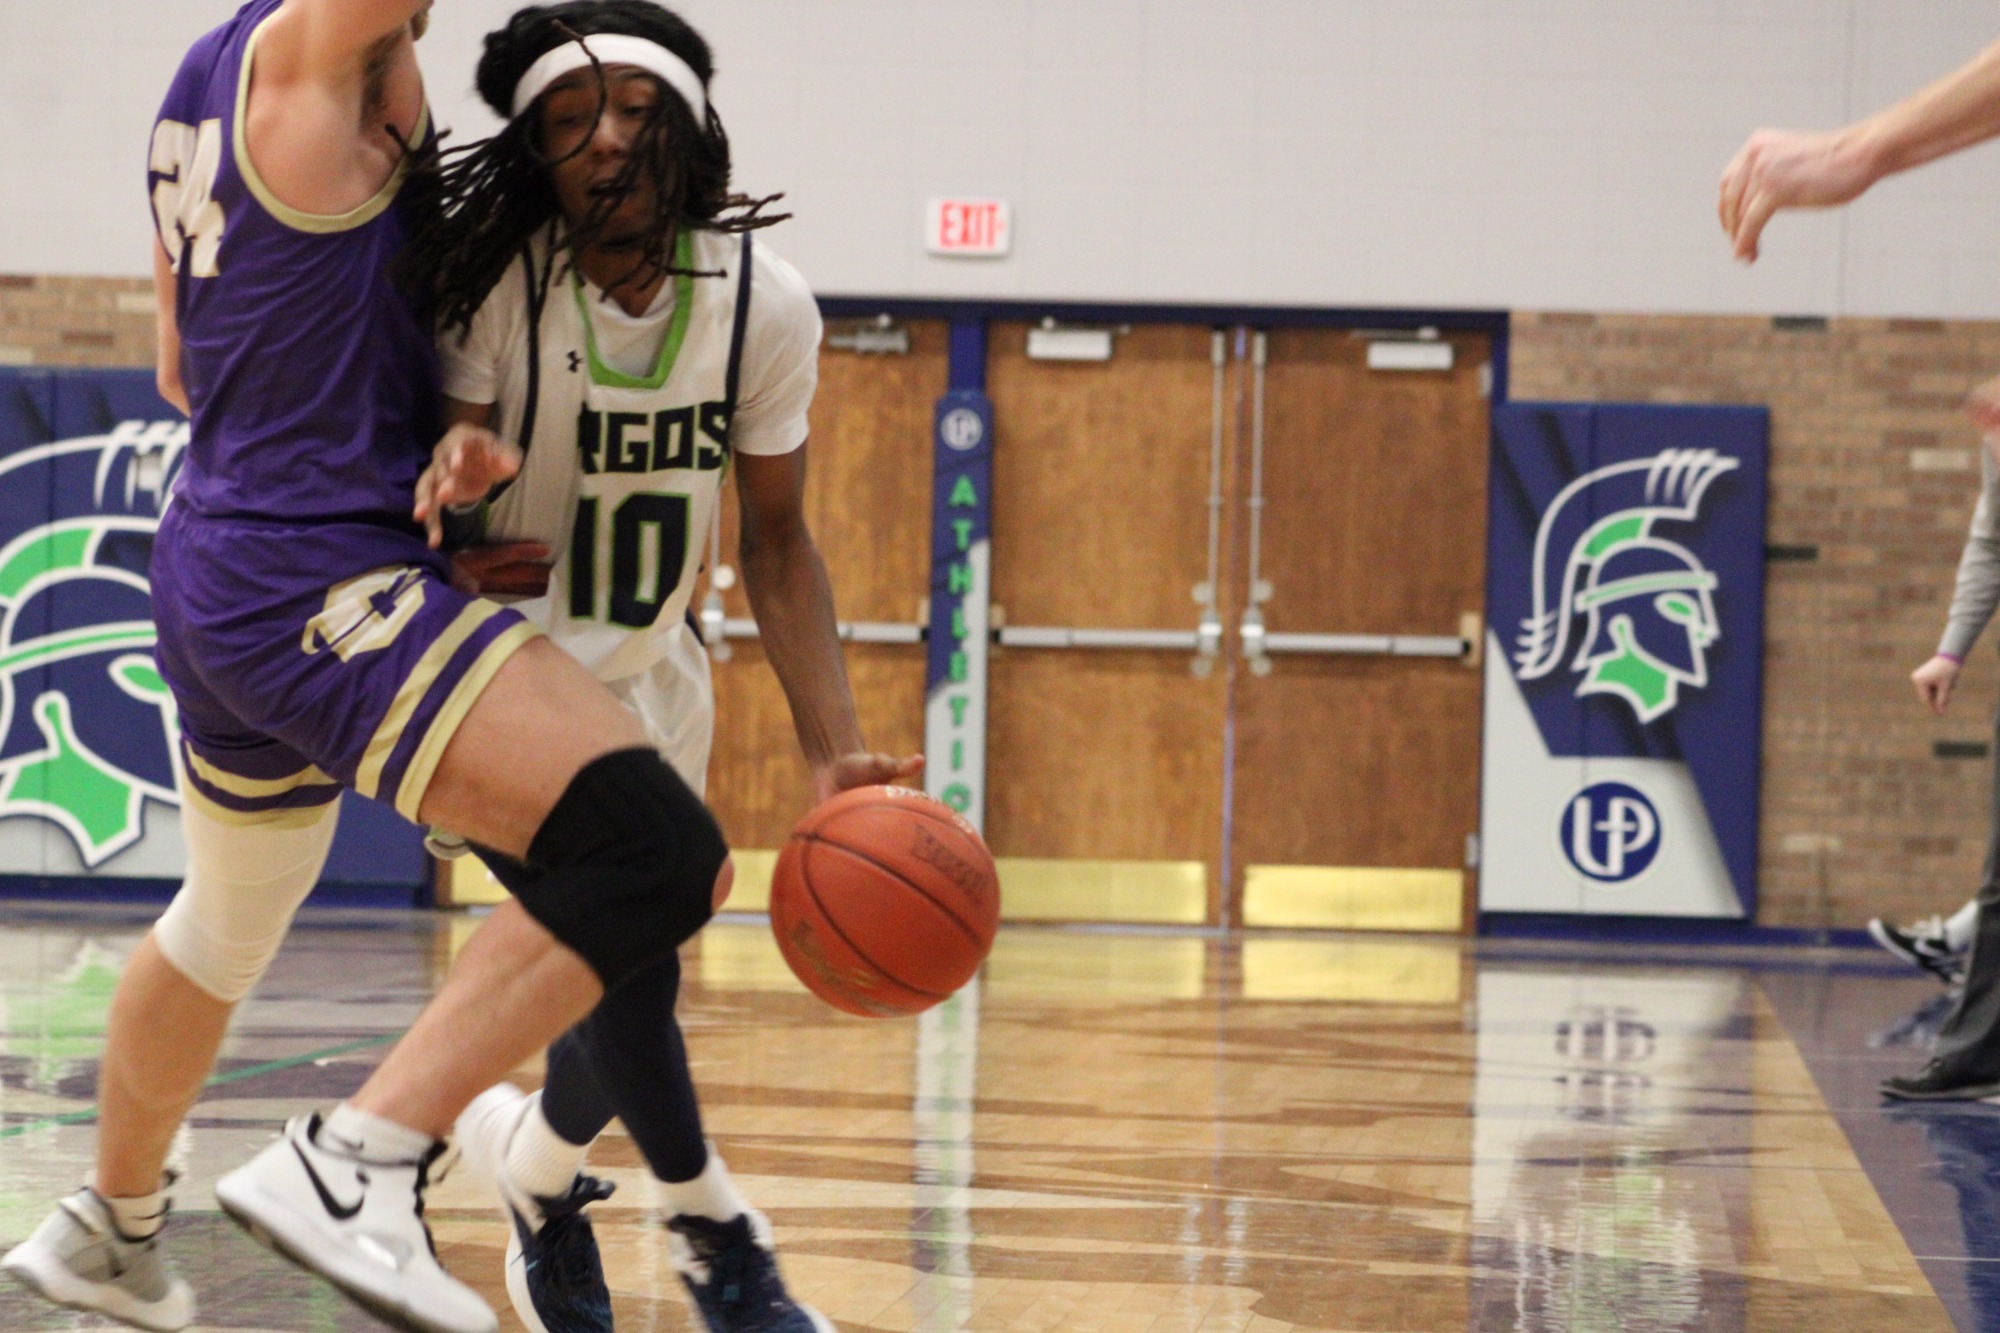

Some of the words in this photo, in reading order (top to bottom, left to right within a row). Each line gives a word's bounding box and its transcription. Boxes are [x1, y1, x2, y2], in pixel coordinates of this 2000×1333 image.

[940, 201, 997, 248] EXIT
[578, 400, 727, 474] RGOS
[569, 491, 690, 630] 10
